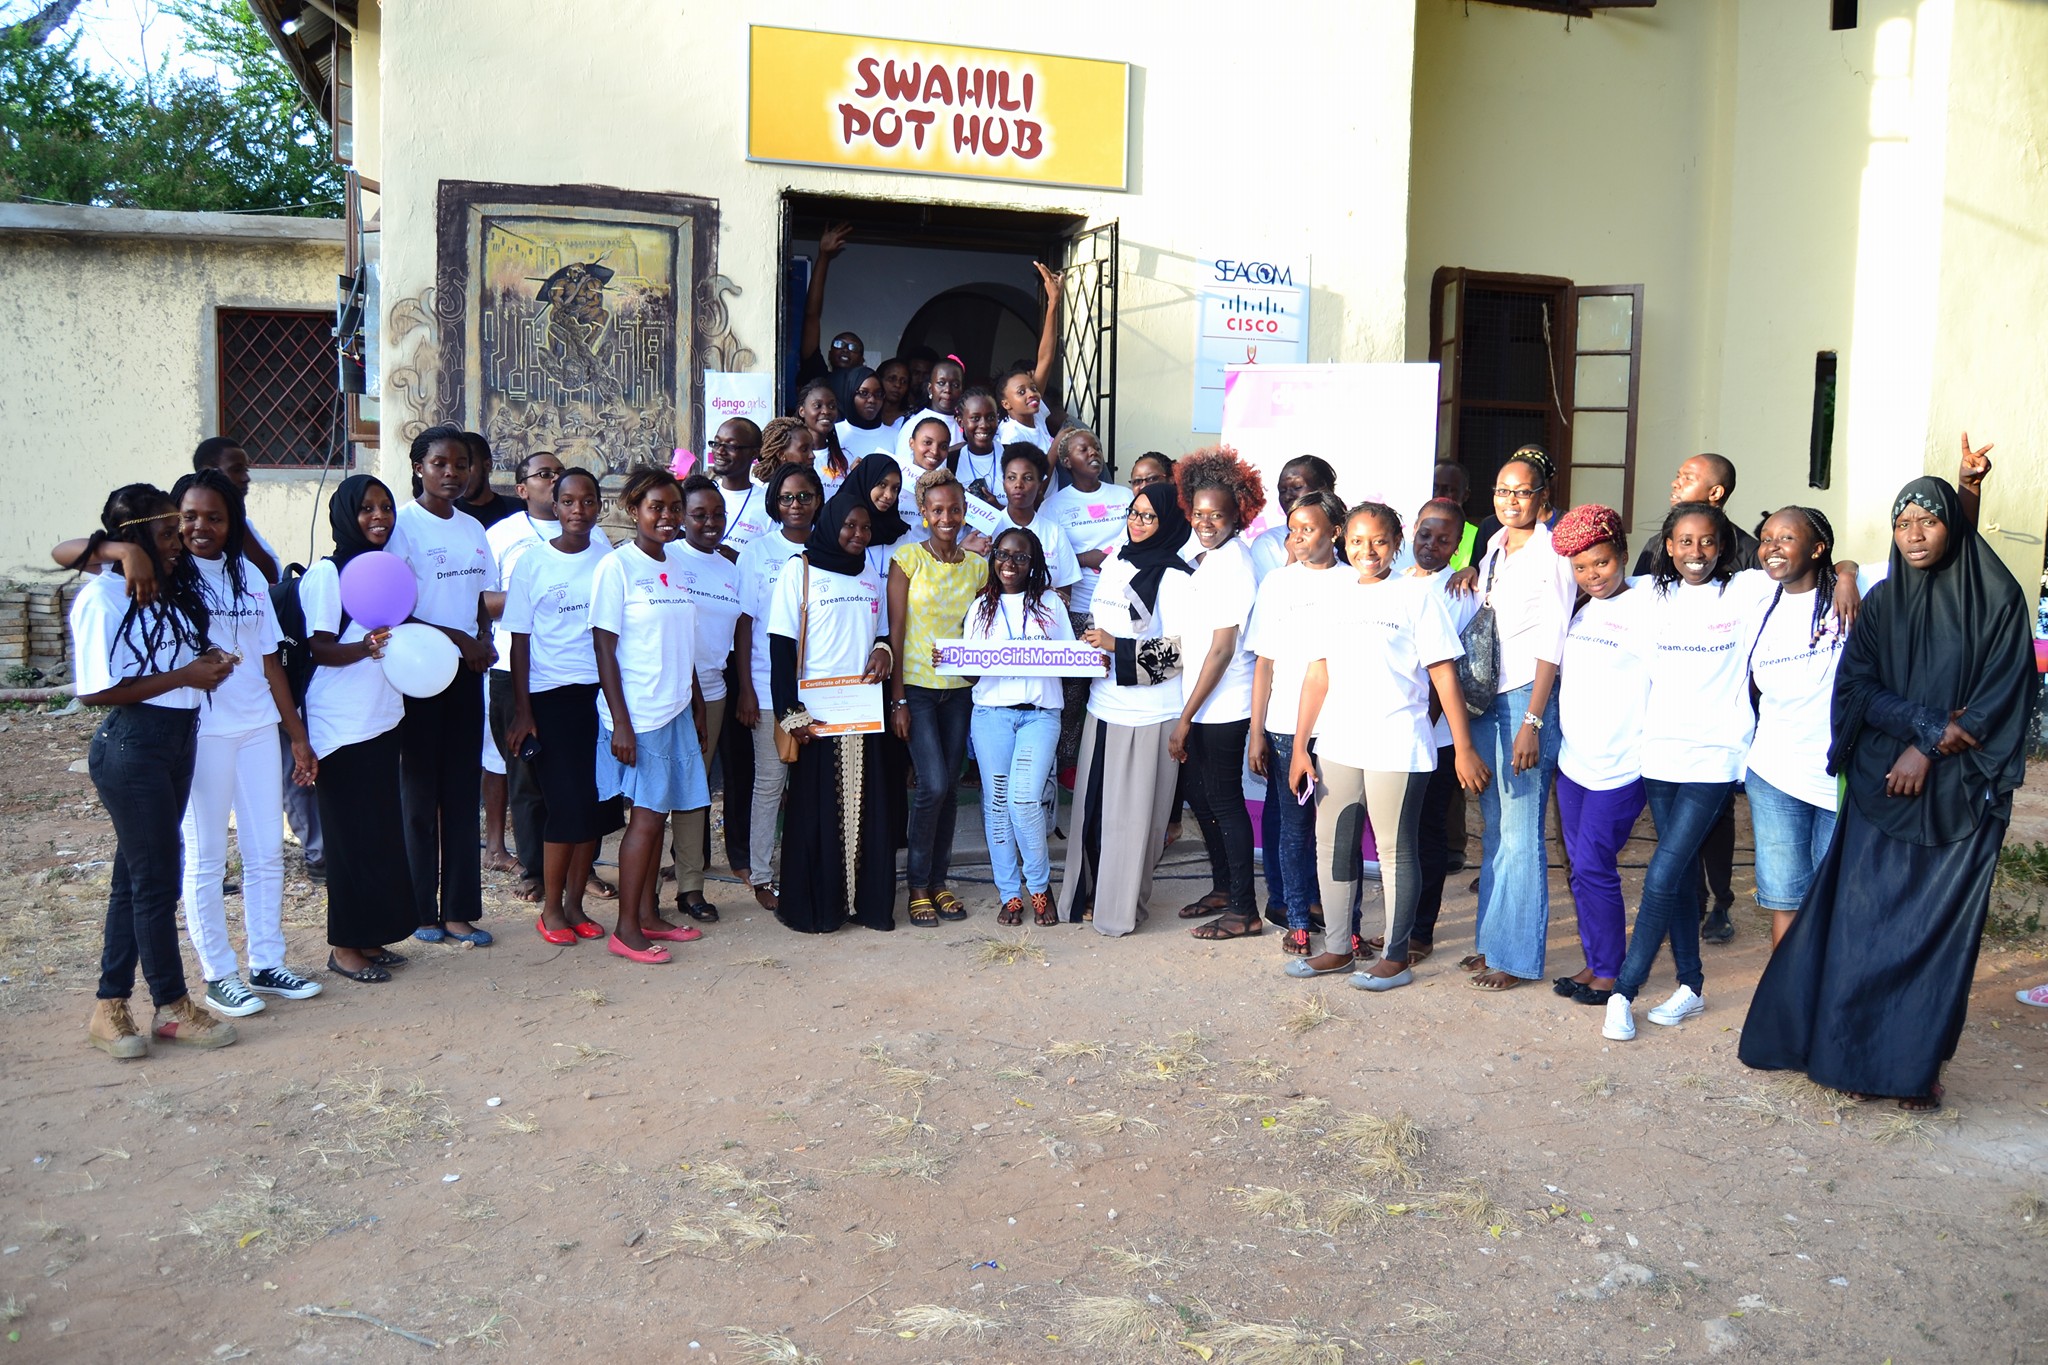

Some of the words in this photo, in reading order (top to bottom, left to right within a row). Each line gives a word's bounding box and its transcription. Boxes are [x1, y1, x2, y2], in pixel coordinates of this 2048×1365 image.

[855, 57, 1033, 113] SWAHILI
[838, 103, 935, 150] POT
[953, 113, 1043, 159] HUB
[1214, 259, 1293, 286] SEACOM
[1226, 317, 1279, 333] CISCO
[711, 397, 746, 411] django
[942, 647, 1100, 667] #DjangoGirlsMombasa
